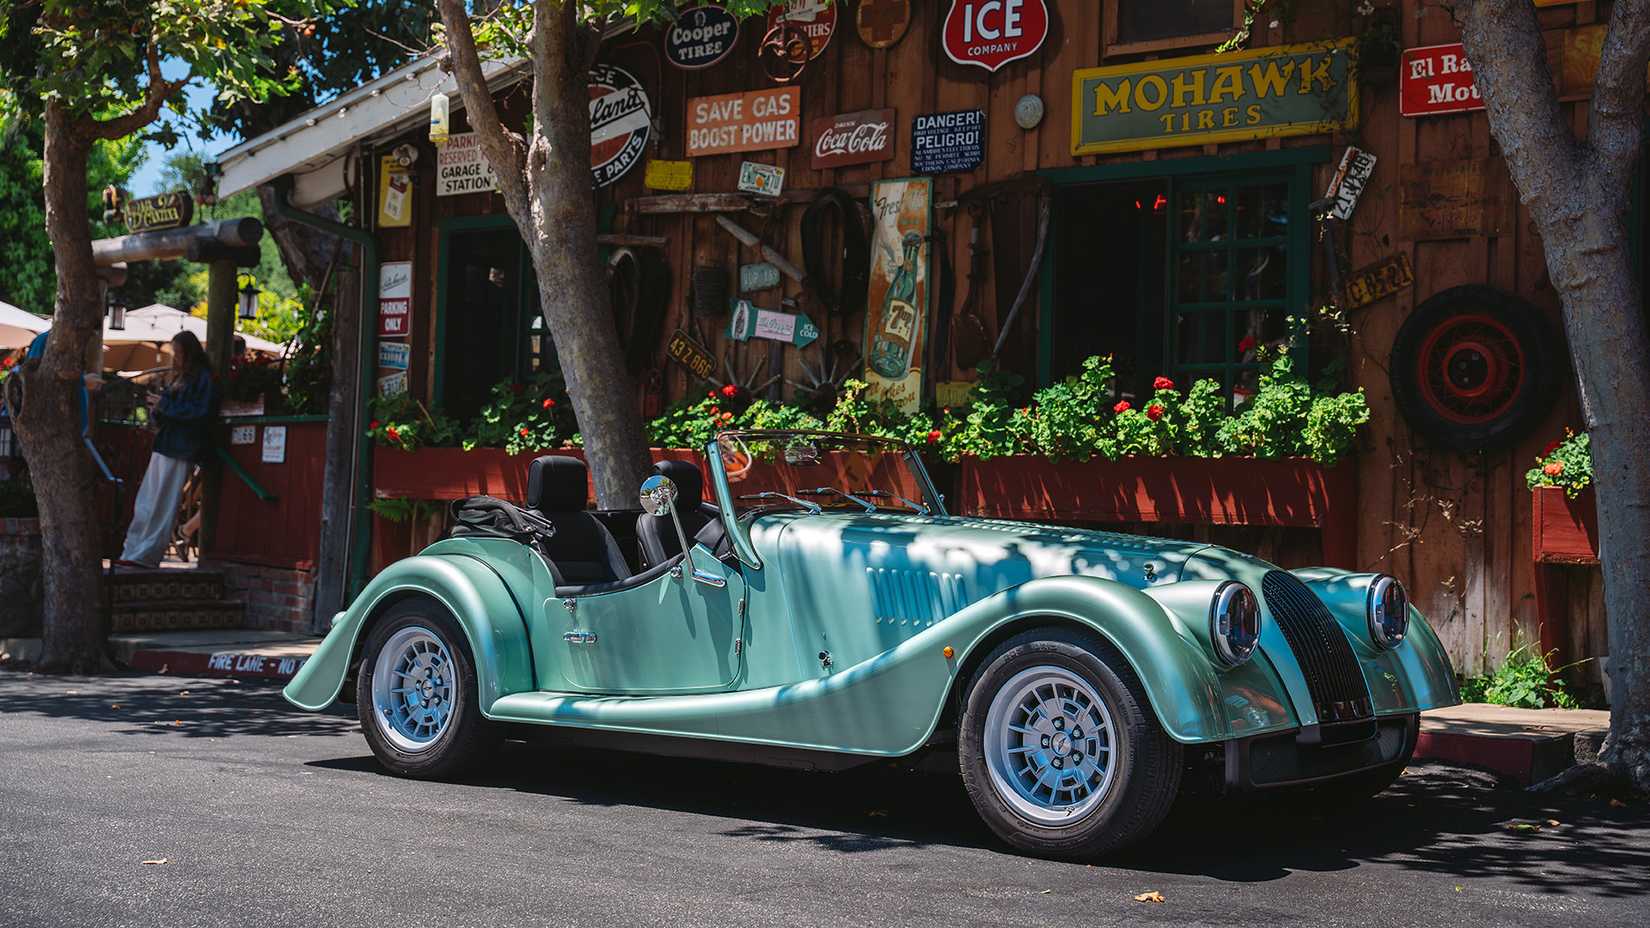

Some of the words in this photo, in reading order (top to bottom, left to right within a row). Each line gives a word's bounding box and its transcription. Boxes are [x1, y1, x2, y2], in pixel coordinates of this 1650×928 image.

[964, 0, 1023, 42] ICE
[673, 21, 731, 45] Cooper
[679, 41, 723, 60] TIRES
[967, 42, 1018, 56] COMPANY
[1409, 57, 1435, 80] El
[1094, 55, 1337, 117] MOHAWK
[696, 99, 743, 124] SAVE
[752, 93, 792, 117] GAS
[917, 111, 979, 129] DANGER!
[1160, 104, 1264, 133] TIRES
[690, 125, 737, 149] BOOST
[742, 119, 796, 145] POWER
[815, 121, 889, 157] Coca-Cola
[916, 131, 980, 149] PELIGRO!
[606, 135, 643, 178] PARTS
[441, 163, 481, 179] GARAGE
[445, 176, 491, 193] STATION
[799, 329, 818, 338] COLD
[208, 655, 234, 670] FIRE
[237, 656, 266, 671] LANE
[278, 659, 296, 674] NO
